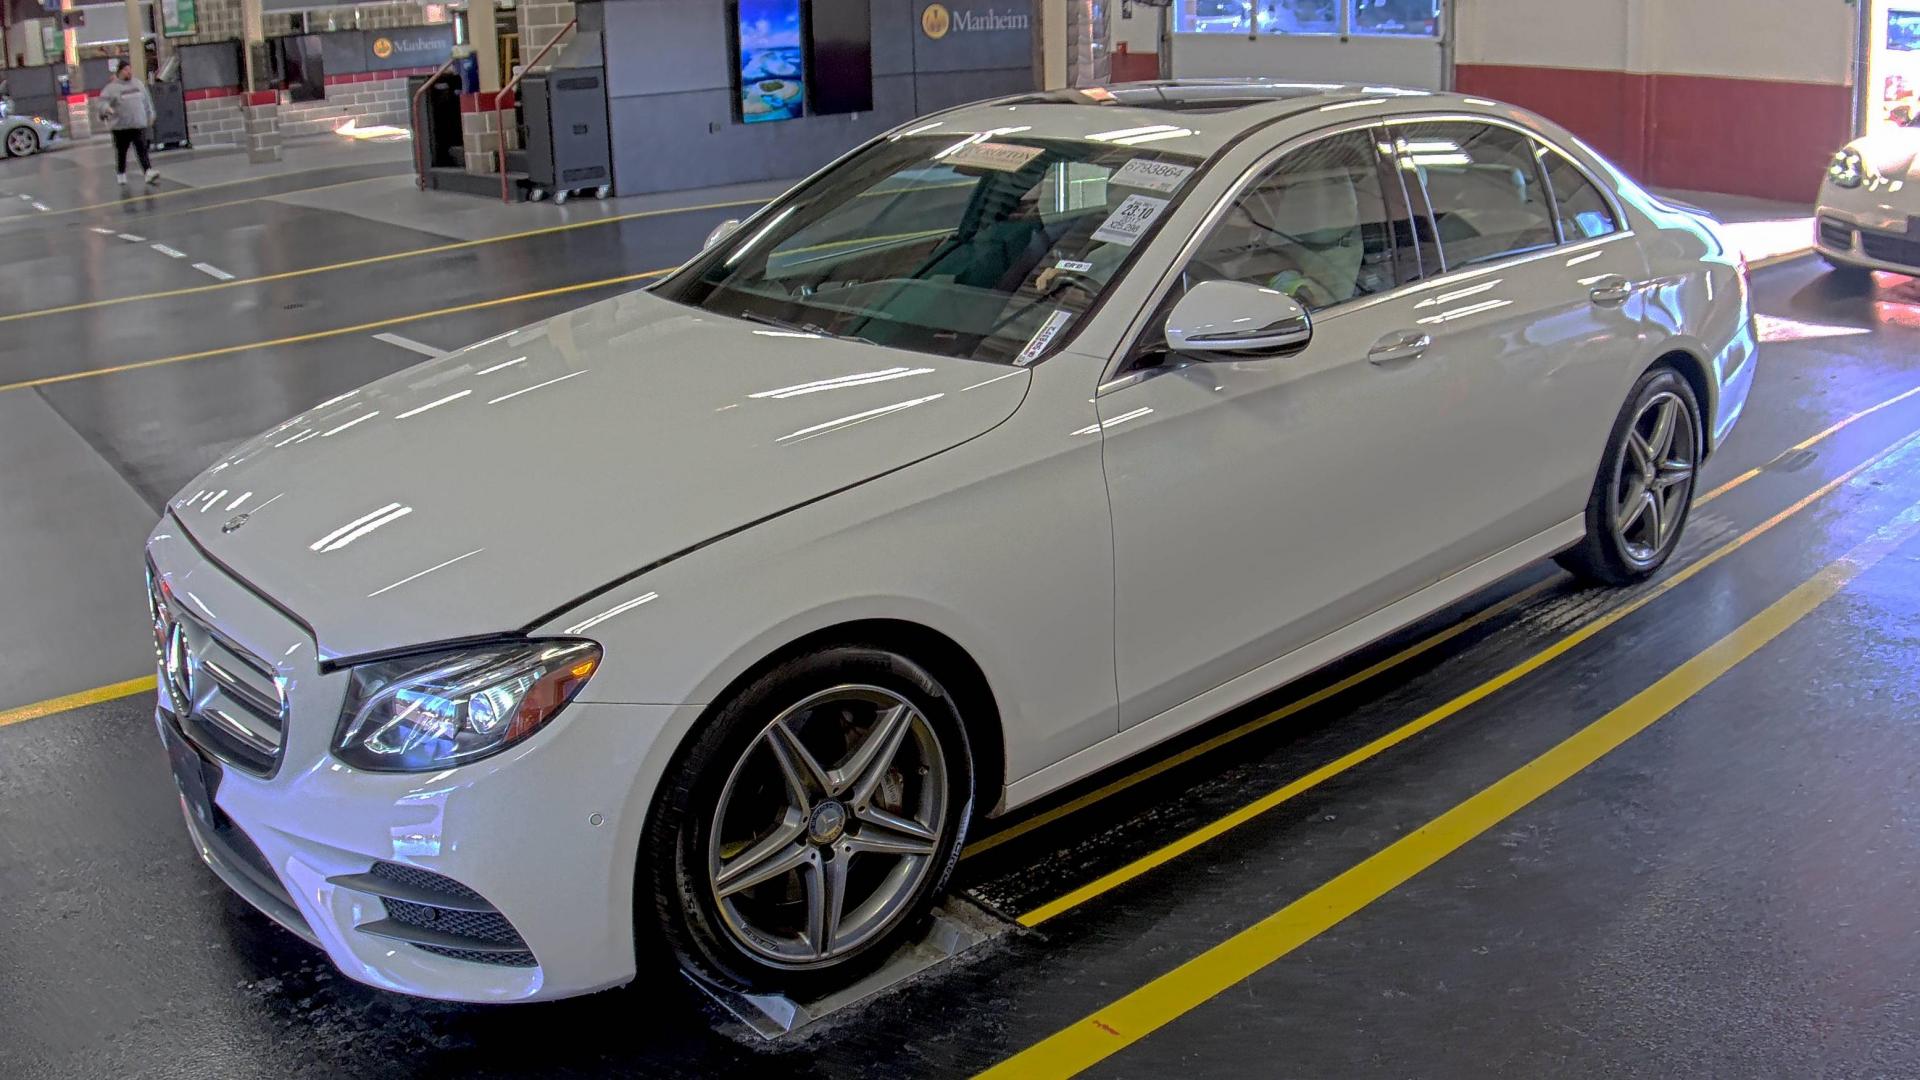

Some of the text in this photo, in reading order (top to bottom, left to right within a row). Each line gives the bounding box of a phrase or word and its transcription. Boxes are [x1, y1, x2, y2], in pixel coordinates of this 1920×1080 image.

[952, 9, 1028, 32] Manheim
[394, 38, 447, 52] Manheim
[1124, 161, 1184, 177] 6793864
